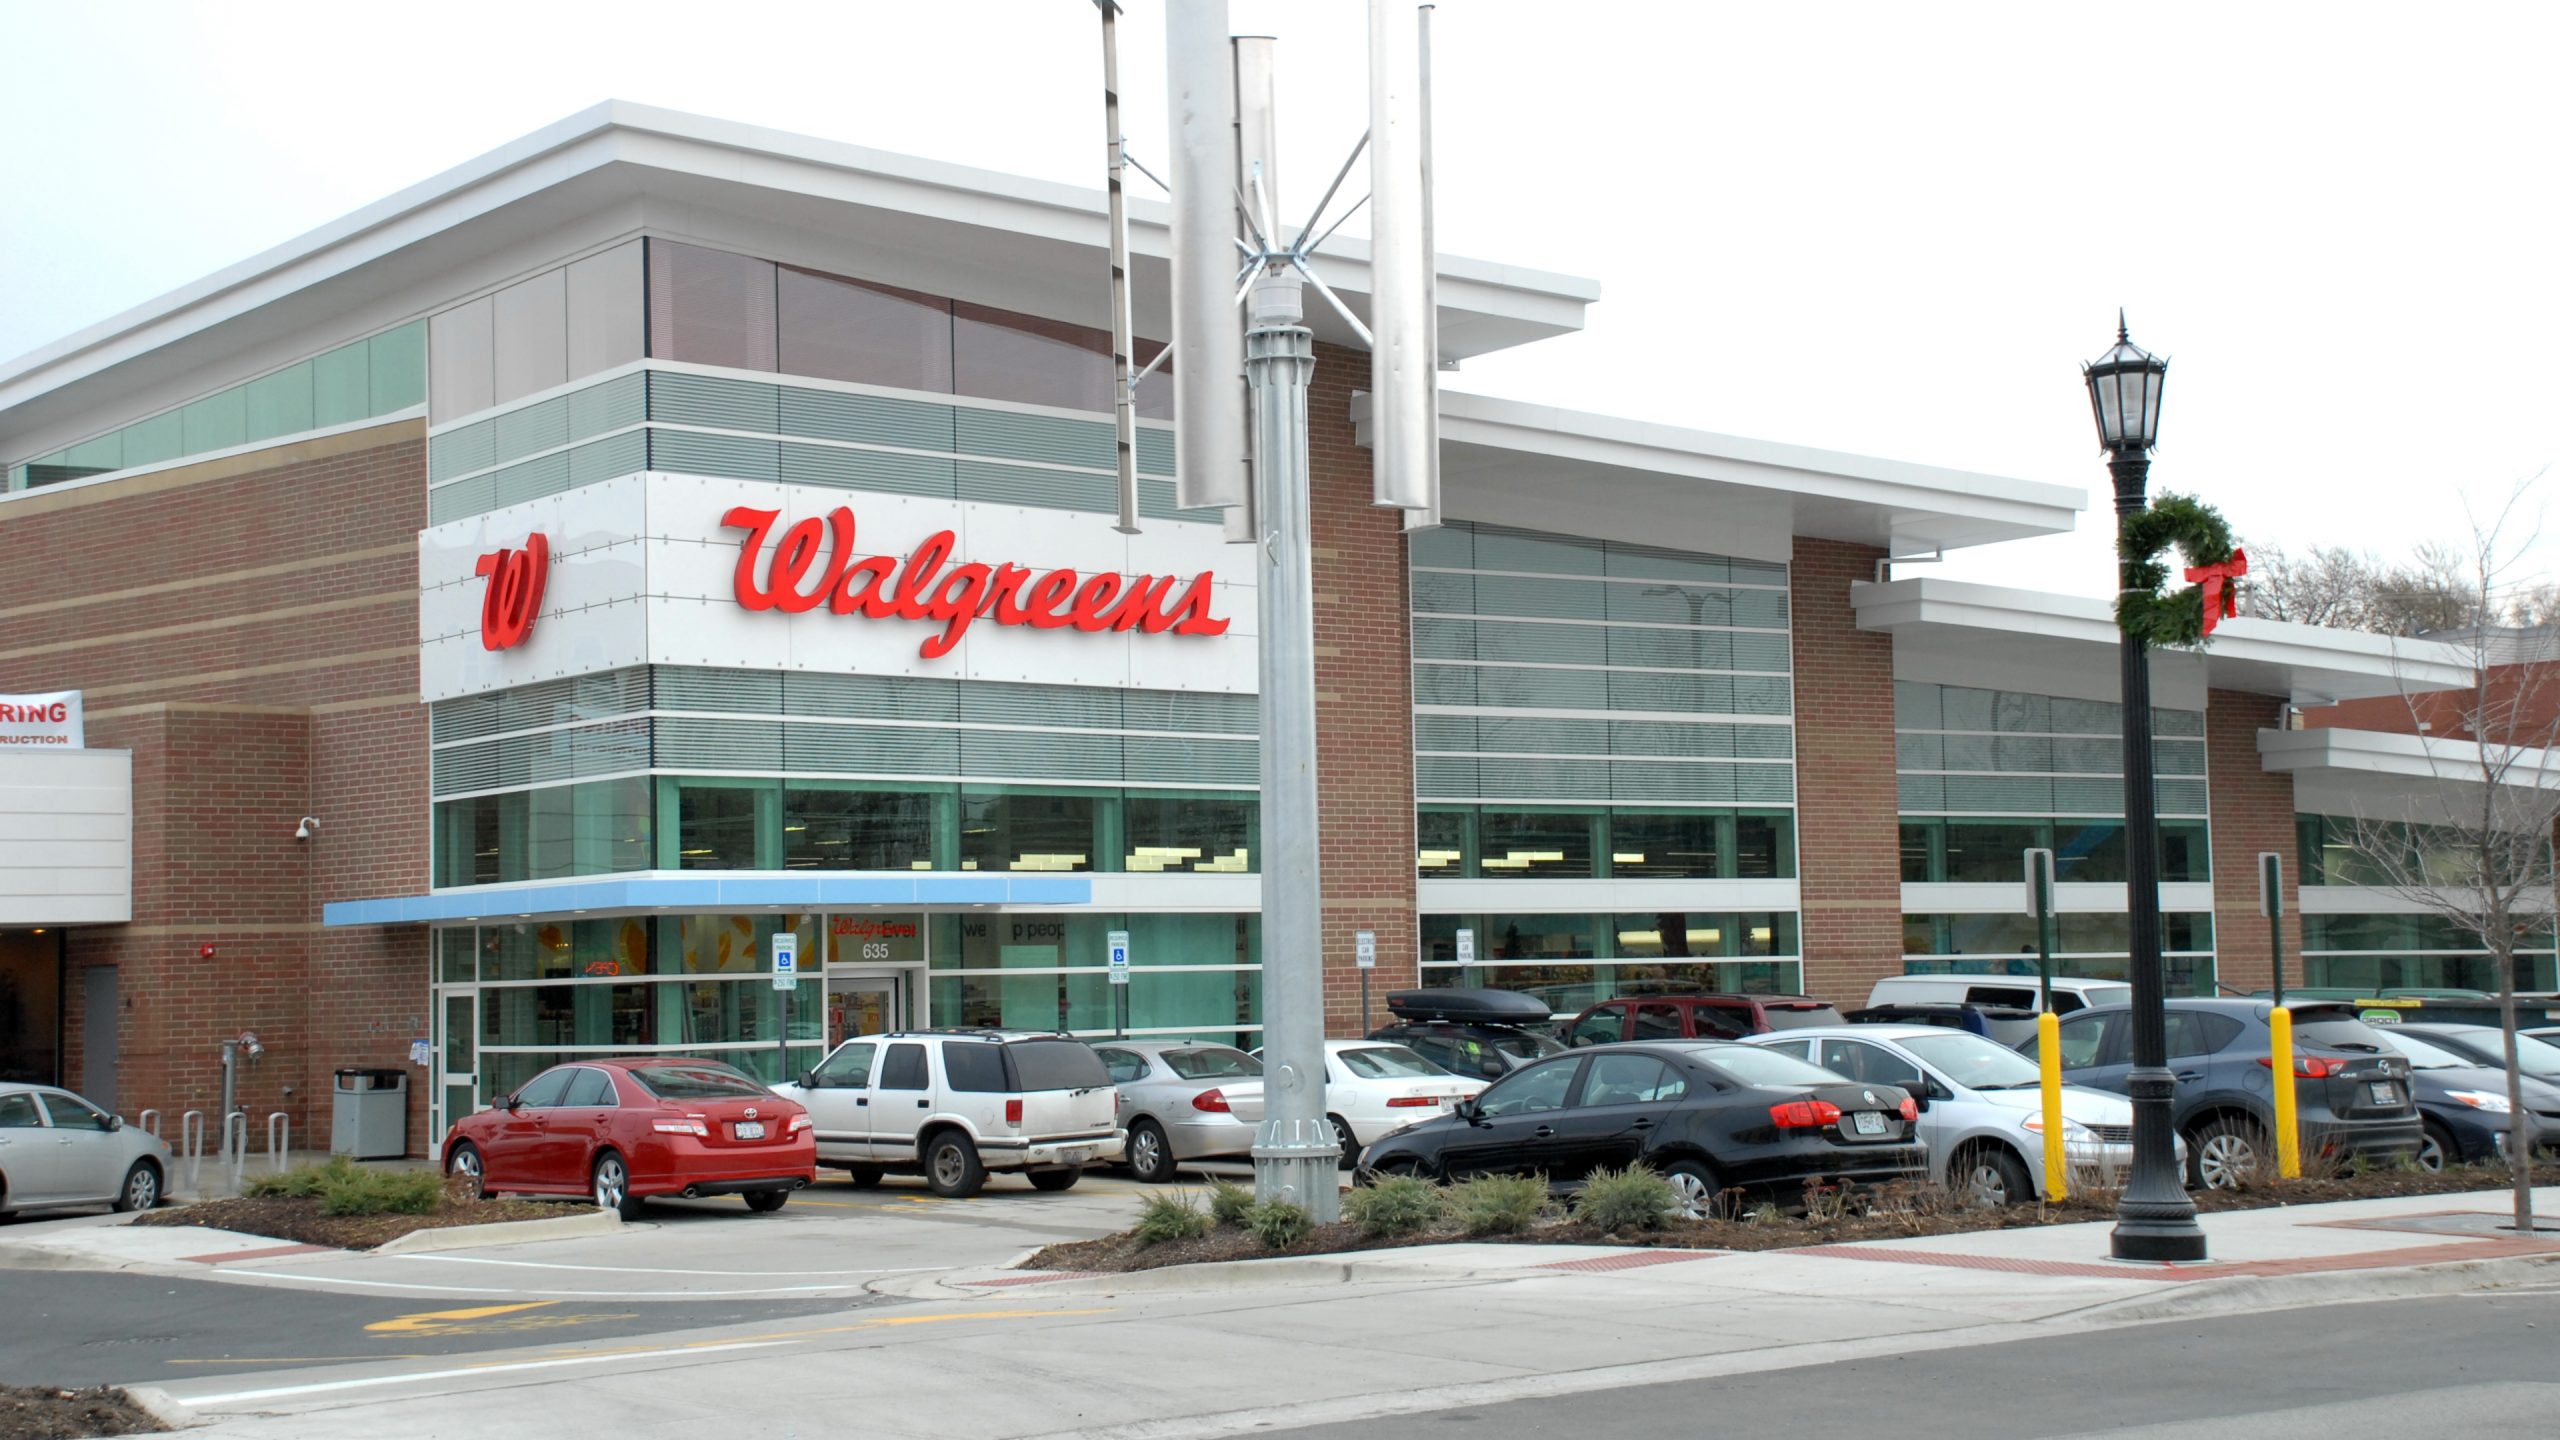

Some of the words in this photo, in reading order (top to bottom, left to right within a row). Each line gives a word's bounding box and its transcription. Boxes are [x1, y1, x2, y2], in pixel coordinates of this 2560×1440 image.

[474, 533, 549, 652] W
[721, 506, 1230, 659] Walgreens
[863, 943, 888, 958] 635
